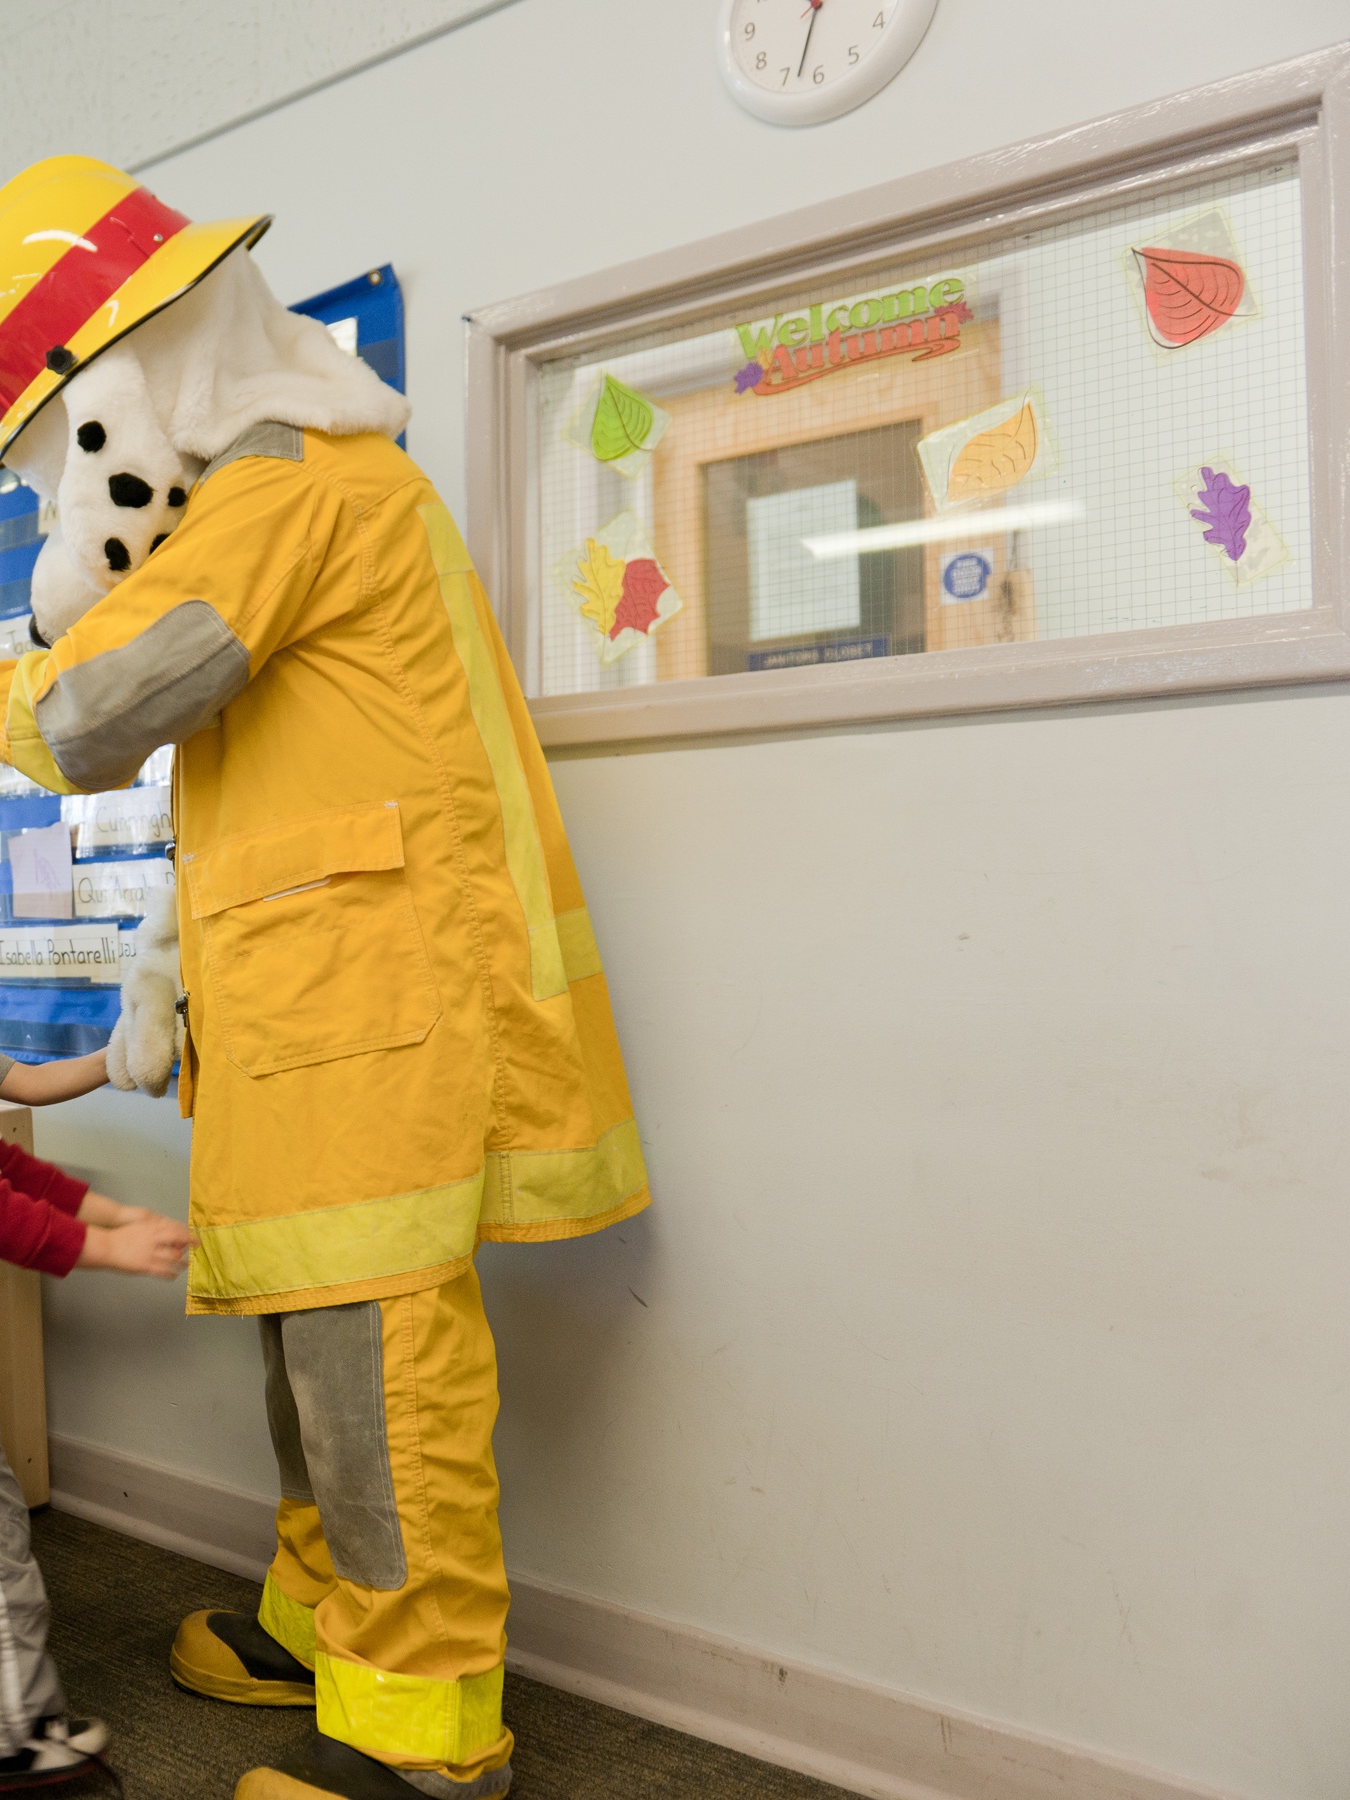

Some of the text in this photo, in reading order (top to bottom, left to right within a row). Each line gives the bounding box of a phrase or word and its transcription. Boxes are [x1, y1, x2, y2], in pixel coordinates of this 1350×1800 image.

[872, 10, 886, 29] 4
[744, 22, 756, 41] 9
[756, 51, 767, 70] 8
[848, 45, 860, 66] 5
[780, 66, 791, 86] 7
[813, 65, 825, 85] 6
[734, 277, 965, 359] Welcome
[762, 310, 961, 386] Autumn
[47, 937, 116, 966] Pontarelli
